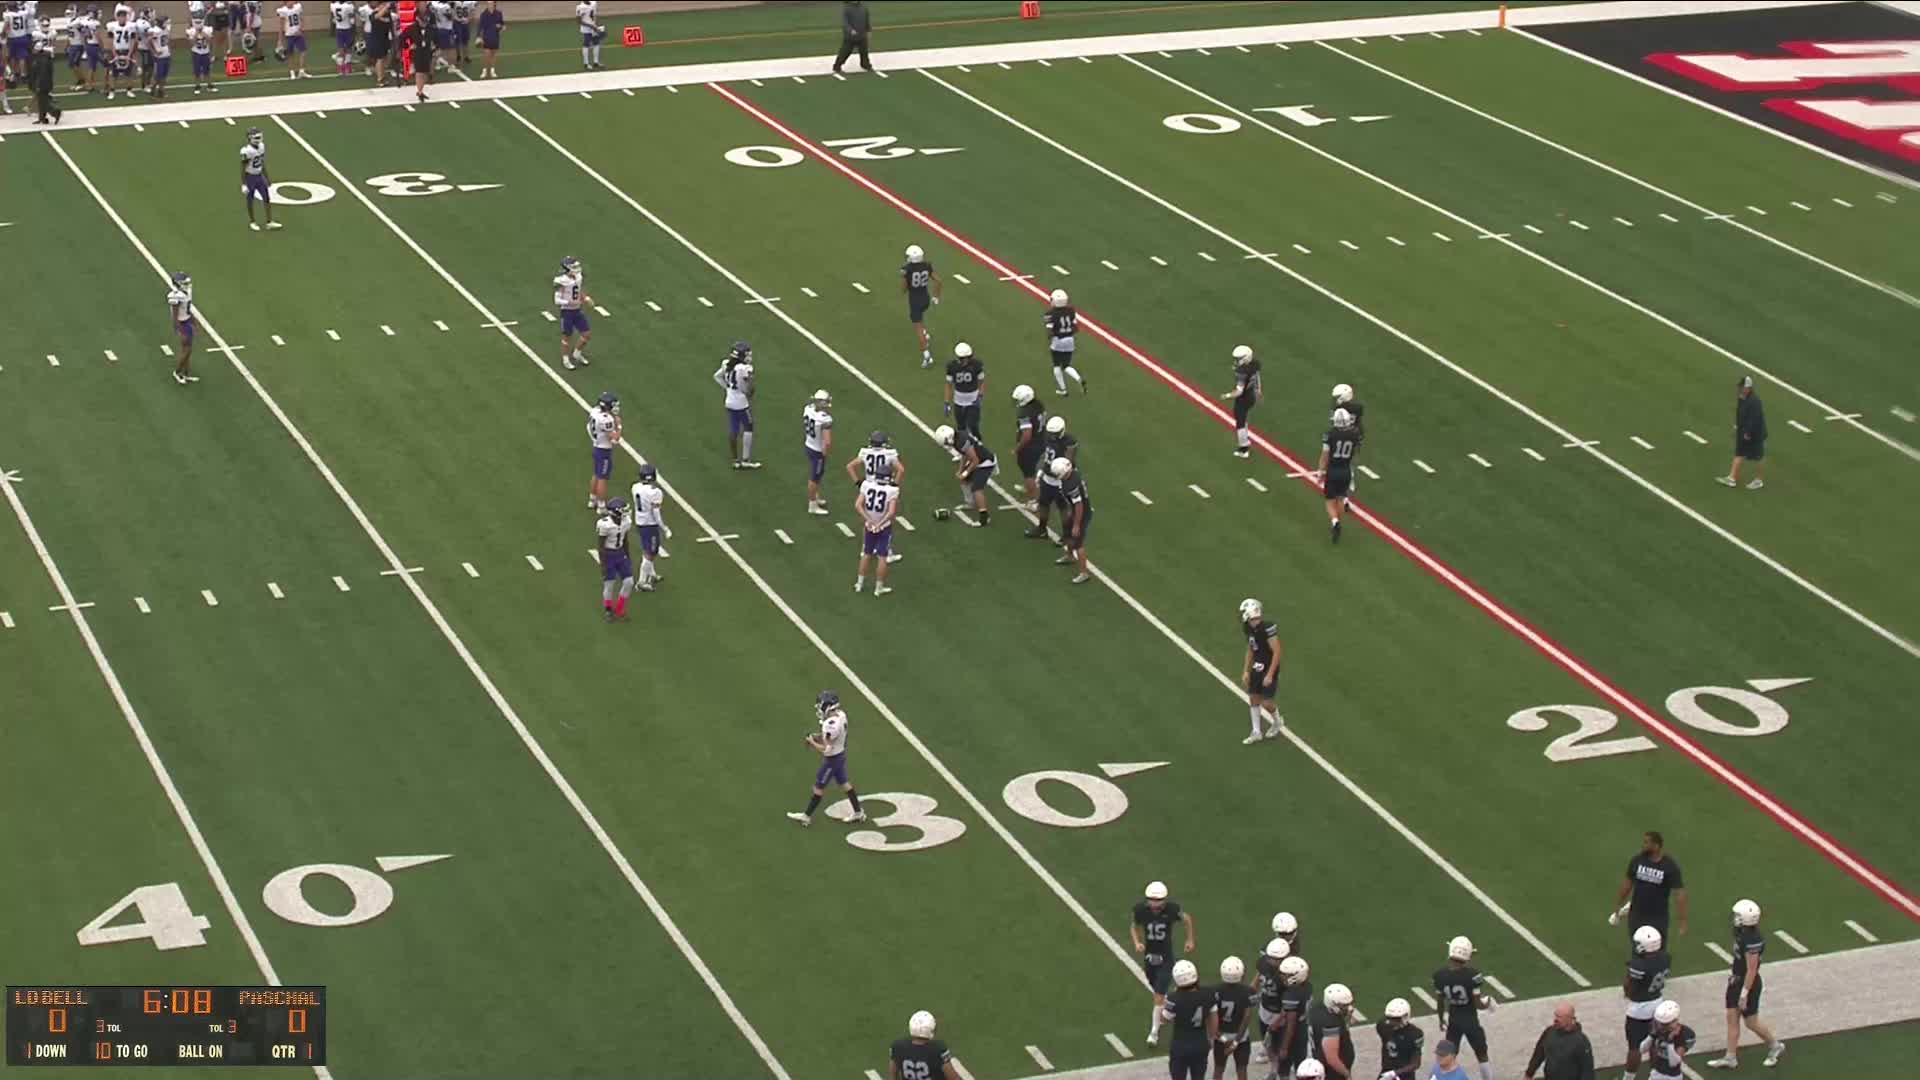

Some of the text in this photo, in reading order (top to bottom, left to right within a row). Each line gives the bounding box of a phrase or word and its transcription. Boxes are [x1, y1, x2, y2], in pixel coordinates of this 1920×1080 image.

[12, 16, 25, 31] 51
[627, 28, 641, 42] 20
[911, 270, 929, 288] 82
[1059, 316, 1073, 333] 11
[1333, 440, 1354, 459] 10
[866, 488, 888, 513] 33
[1147, 922, 1167, 941] 15
[1443, 984, 1469, 1006] 13
[1221, 1001, 1235, 1023] 7
[902, 1059, 930, 1080] 62
